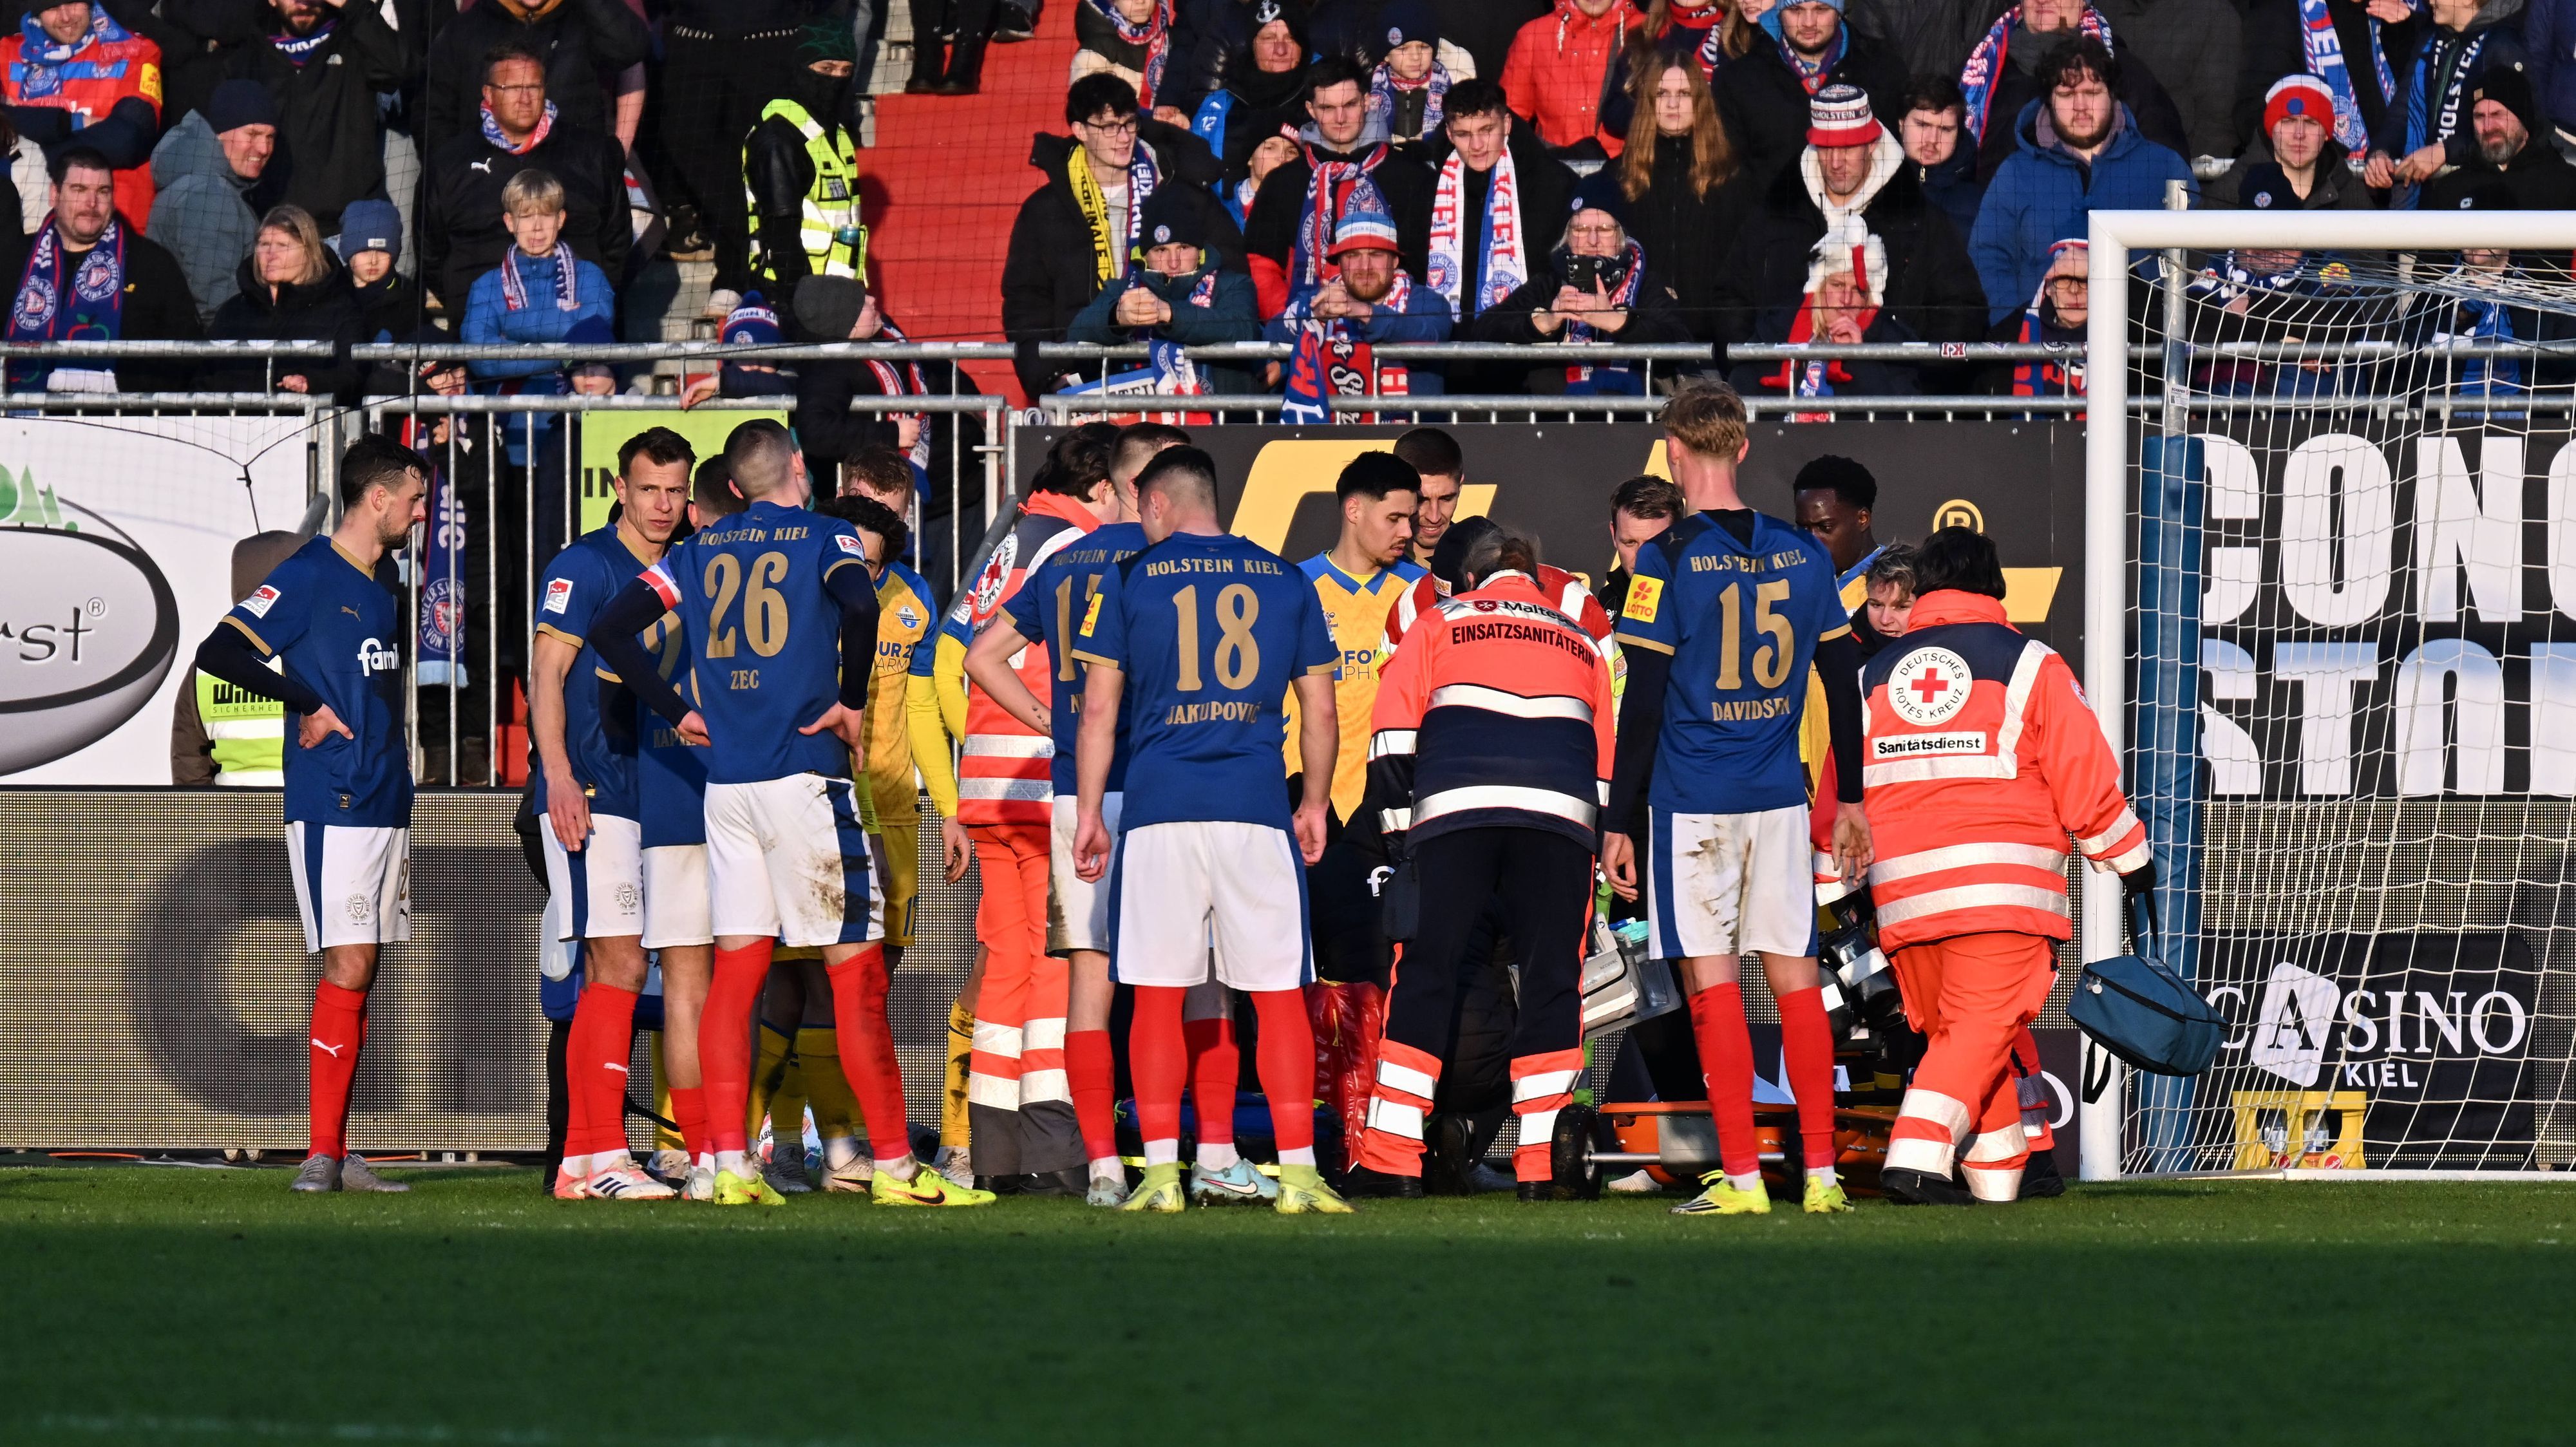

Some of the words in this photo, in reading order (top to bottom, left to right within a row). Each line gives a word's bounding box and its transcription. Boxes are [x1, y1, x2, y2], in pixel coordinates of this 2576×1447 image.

[699, 528, 766, 546] HOLSTEIN
[773, 527, 810, 541] KIEL
[2191, 432, 2576, 627] CON
[1146, 558, 1233, 577] HOLSTEIN
[1244, 559, 1283, 576] KIEL
[1690, 553, 1765, 573] HOLSTEIN
[1772, 549, 1806, 570] KIEL
[704, 551, 789, 659] 26
[1626, 601, 1653, 617] LOTTO
[1172, 583, 1260, 692] 18
[1452, 623, 1595, 670] EINSATZSANITÄTERIN
[1716, 578, 1794, 690] 15
[1900, 652, 1964, 679] DEUTSCHES
[730, 669, 759, 690] ZEC
[213, 705, 279, 714] SICHERHEI
[1711, 695, 1791, 722] DAVIDSEN
[1895, 686, 1924, 719] ROTES
[1929, 688, 1964, 719] KREUZ
[1878, 737, 1980, 754] Sanitätsdienst
[2205, 987, 2526, 1055] CASINO
[2346, 1063, 2418, 1088] KIEL
